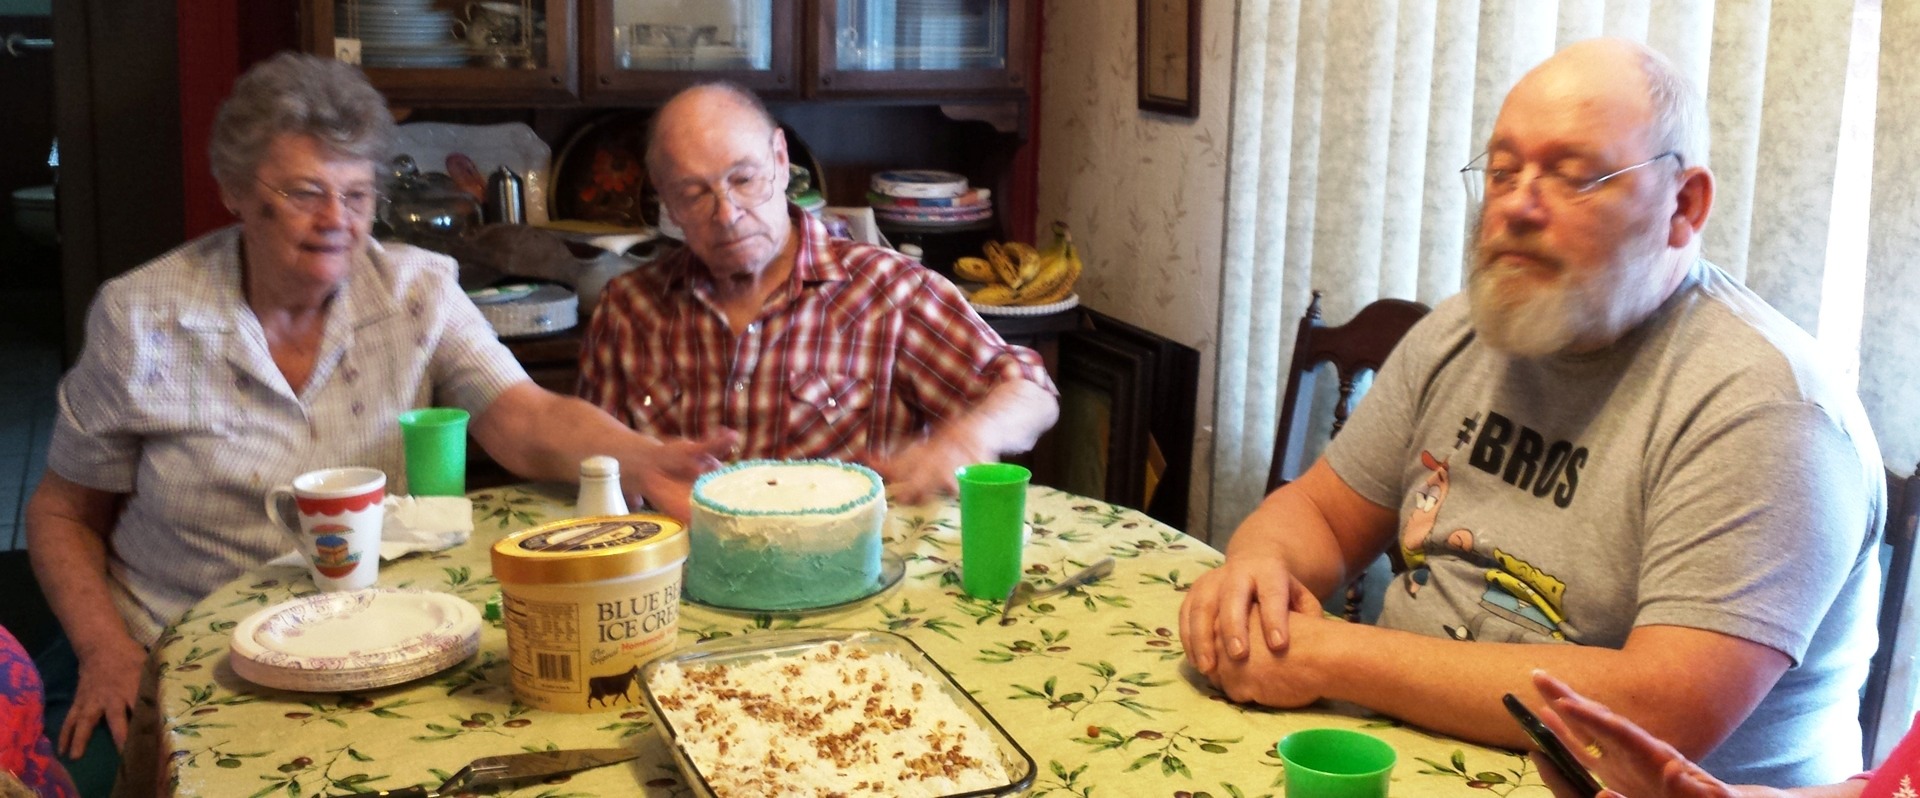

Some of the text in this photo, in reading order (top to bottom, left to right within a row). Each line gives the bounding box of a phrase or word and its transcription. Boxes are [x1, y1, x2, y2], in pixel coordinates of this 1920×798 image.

[1453, 410, 1589, 509] #BROS
[597, 591, 660, 622] BLUE
[598, 619, 639, 643] ICE
